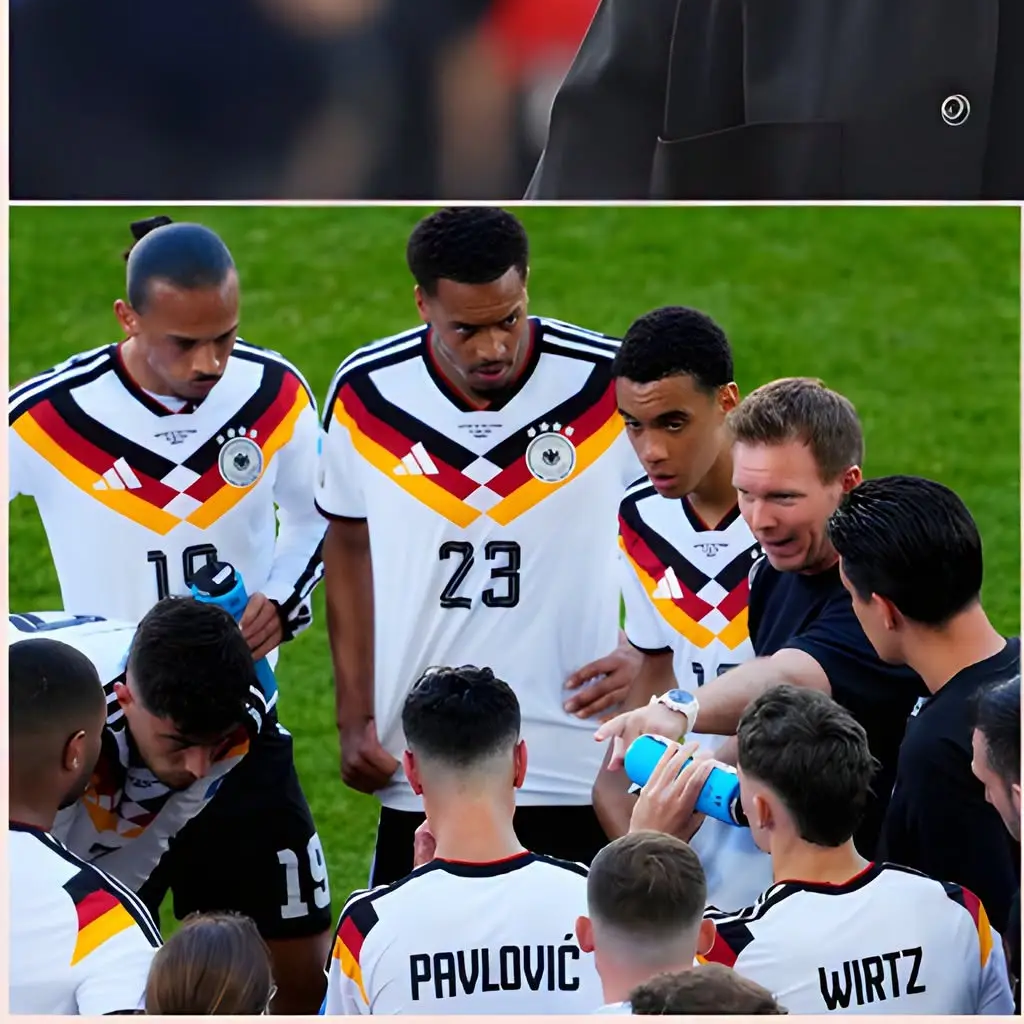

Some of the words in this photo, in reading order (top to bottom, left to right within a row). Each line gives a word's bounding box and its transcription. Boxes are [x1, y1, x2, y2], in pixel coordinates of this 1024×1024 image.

[439, 541, 521, 609] 23
[276, 831, 331, 919] 19
[410, 933, 580, 1001] PAVLOVIĆ
[818, 946, 926, 1011] WIRTZ
